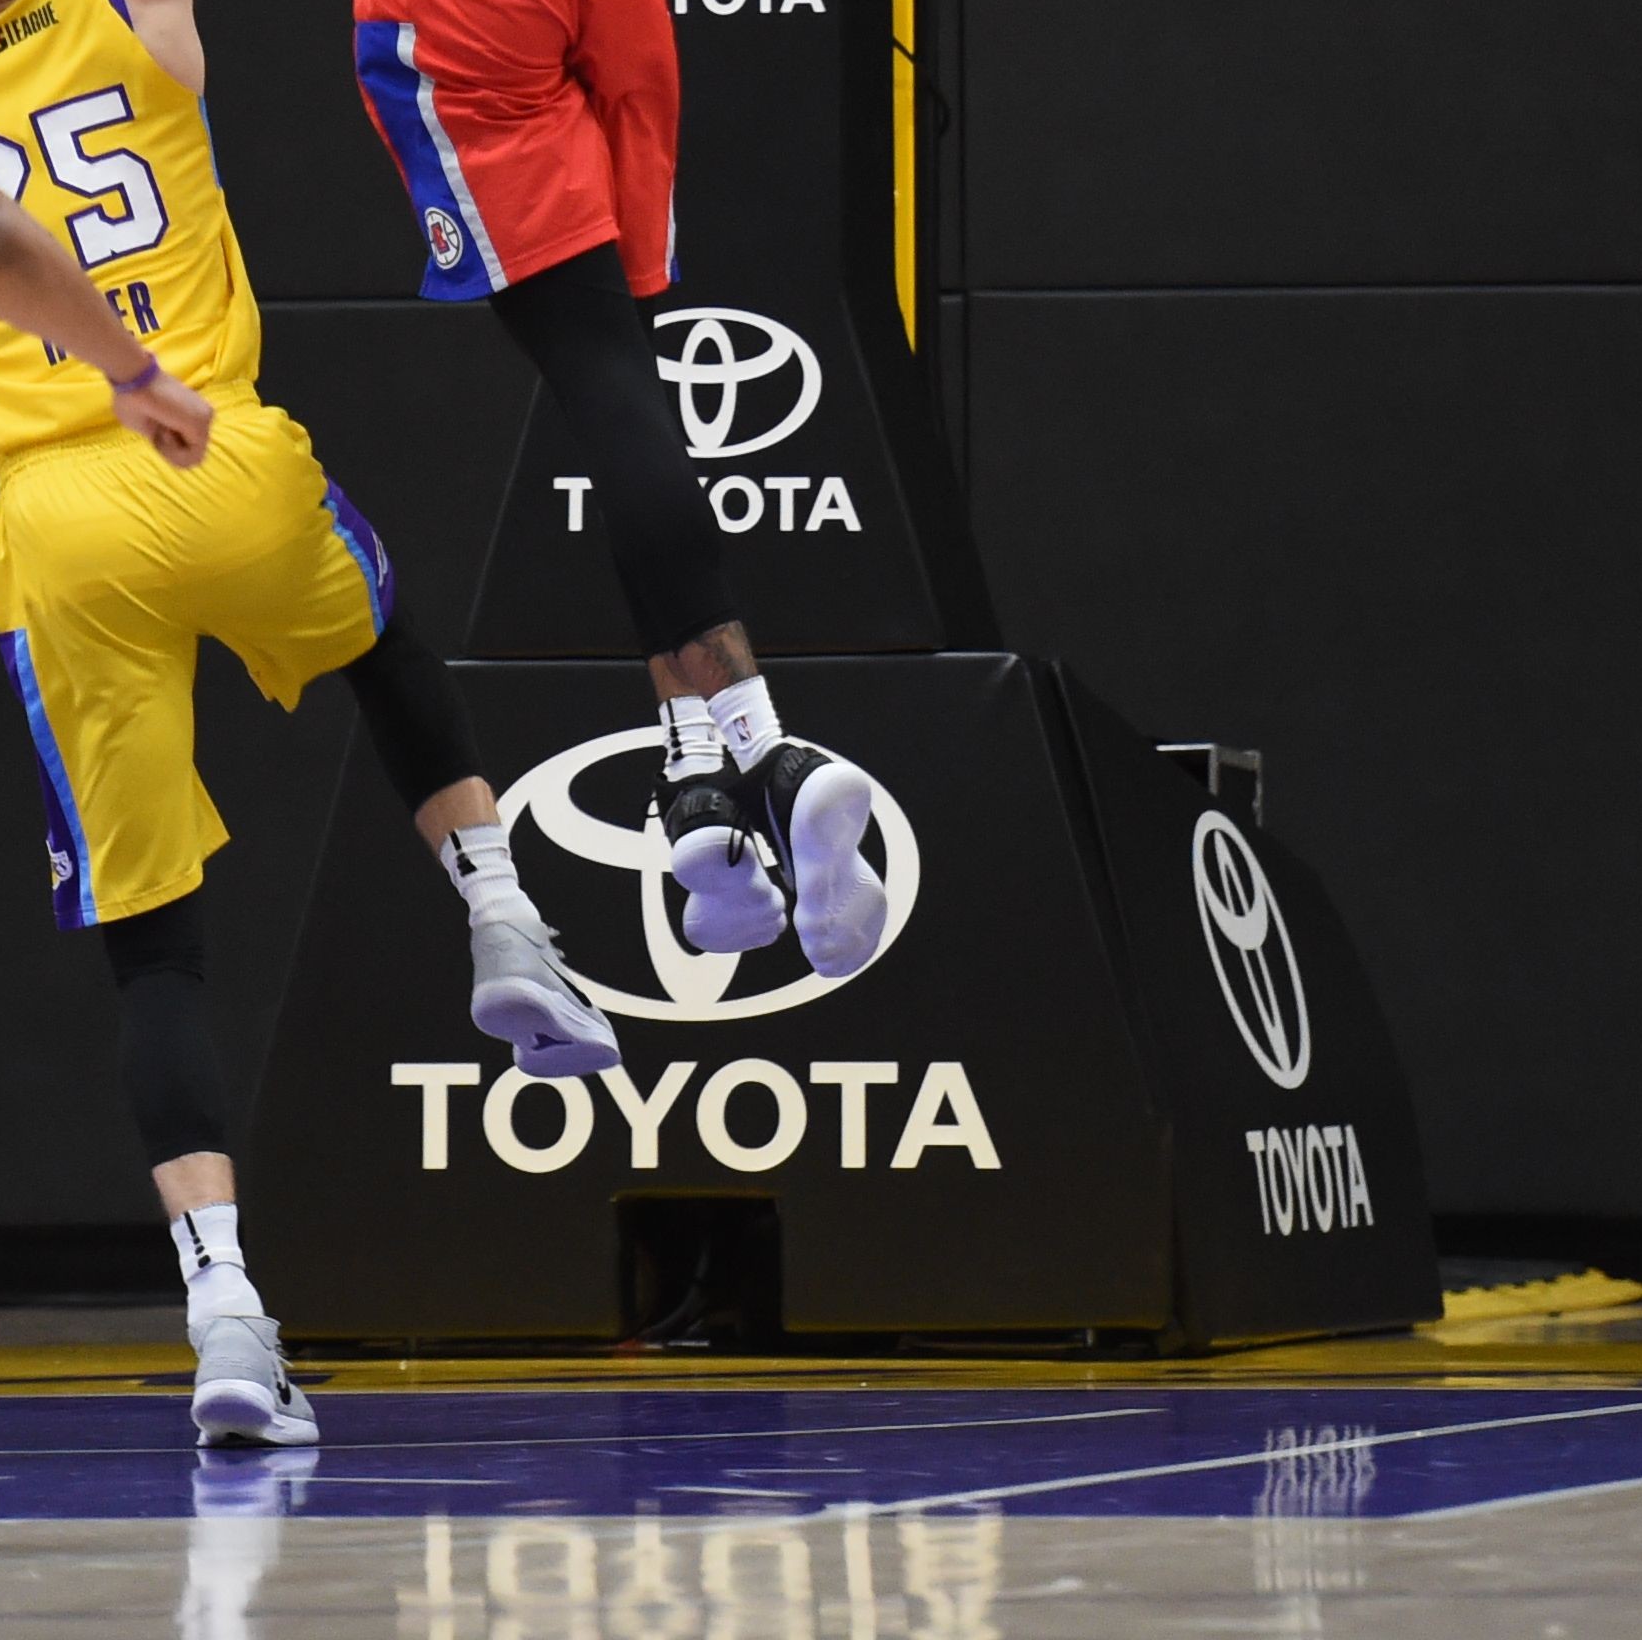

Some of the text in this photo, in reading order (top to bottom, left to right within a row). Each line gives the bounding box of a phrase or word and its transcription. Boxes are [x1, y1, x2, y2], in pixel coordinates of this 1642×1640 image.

[553, 475, 862, 534] TOTA
[390, 1058, 1002, 1174] TOYOTA
[1245, 1123, 1374, 1236] TOYOTA
